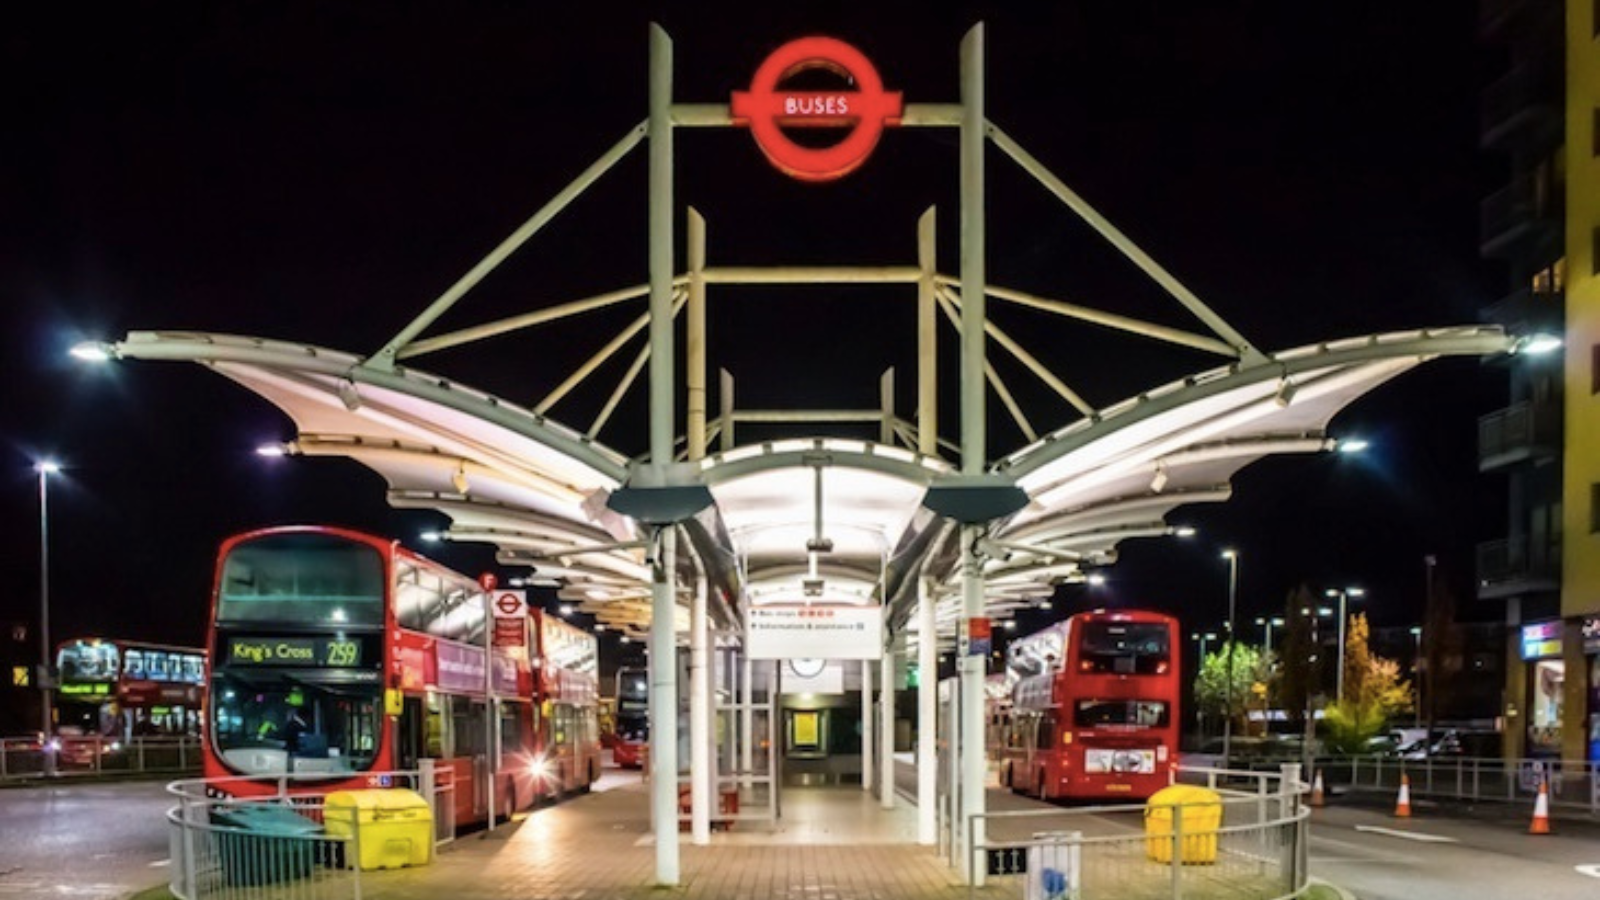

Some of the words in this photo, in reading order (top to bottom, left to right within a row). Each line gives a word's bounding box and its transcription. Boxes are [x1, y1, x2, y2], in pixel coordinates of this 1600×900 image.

[785, 96, 848, 114] BUSES
[232, 643, 273, 662] King's
[275, 643, 313, 659] Cross
[326, 641, 357, 666] 259
